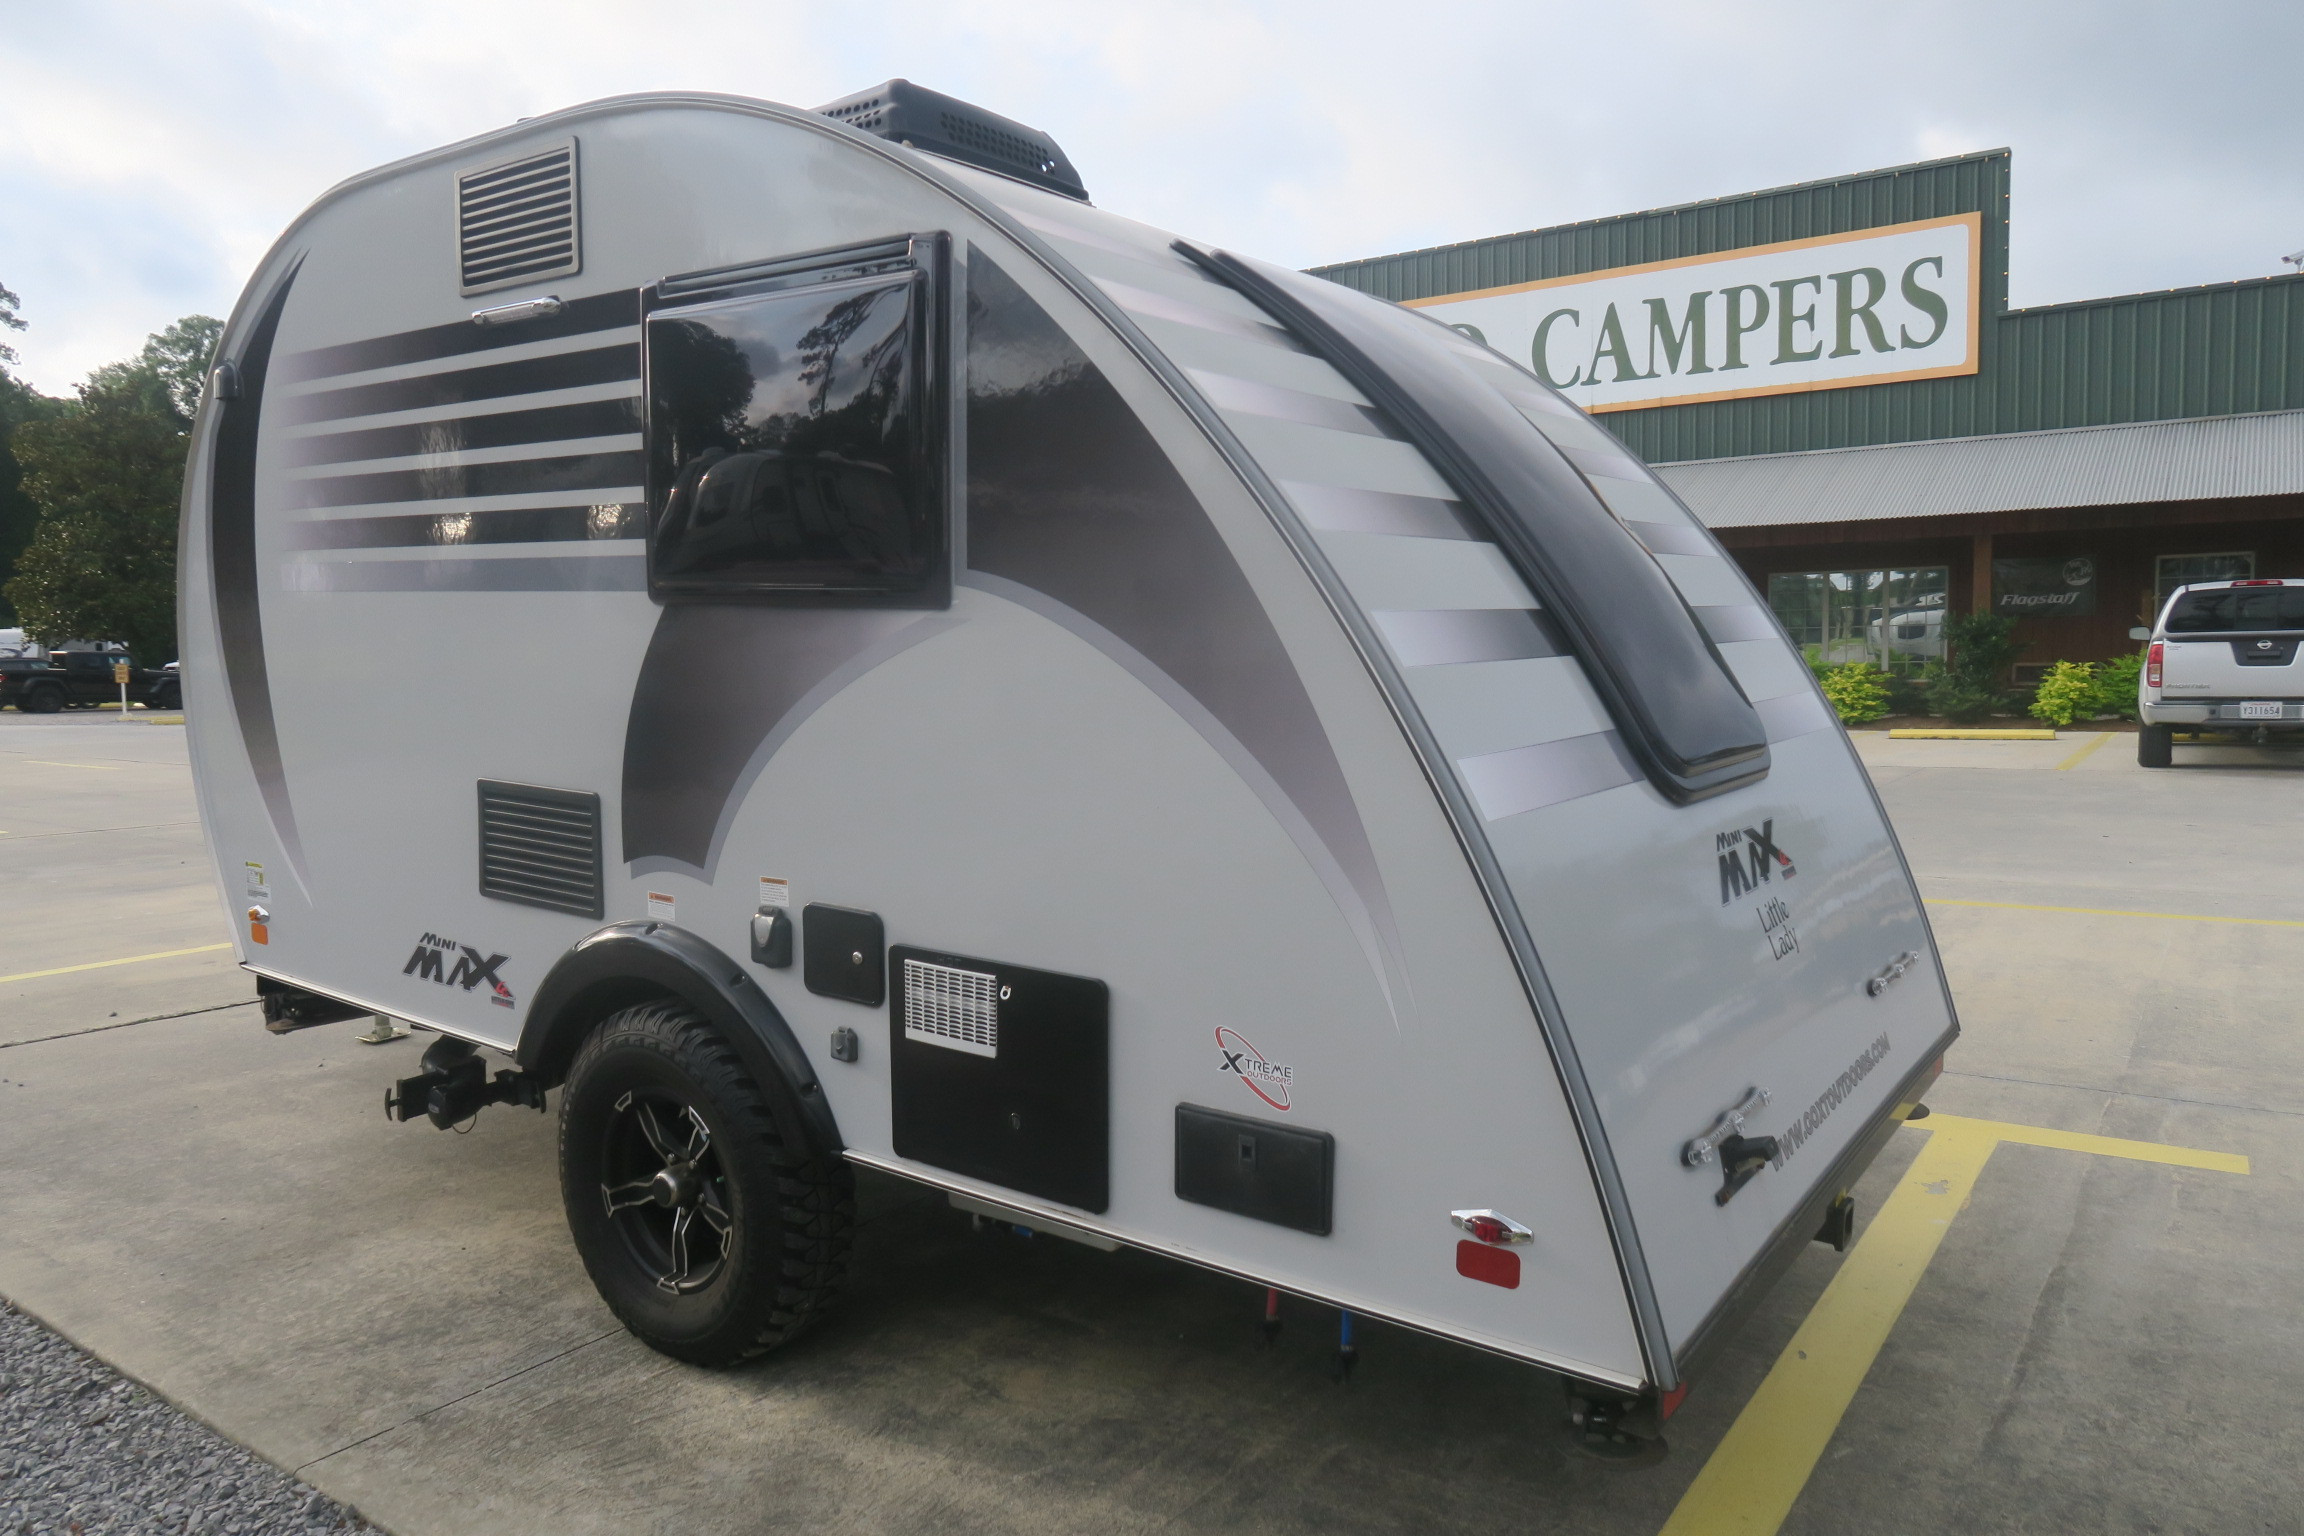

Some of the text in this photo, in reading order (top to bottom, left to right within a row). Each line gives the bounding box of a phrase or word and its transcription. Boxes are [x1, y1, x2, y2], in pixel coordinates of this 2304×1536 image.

[1531, 255, 1949, 390] CAMPERS
[2000, 591, 2080, 607] Flagstaff
[1718, 818, 1793, 906] MAX
[1756, 896, 1789, 933] Little
[1767, 924, 1799, 961] Lady
[402, 944, 516, 999] MAX
[1219, 1049, 1292, 1079] XTREME
[1247, 1070, 1292, 1086] OUTDOORS
